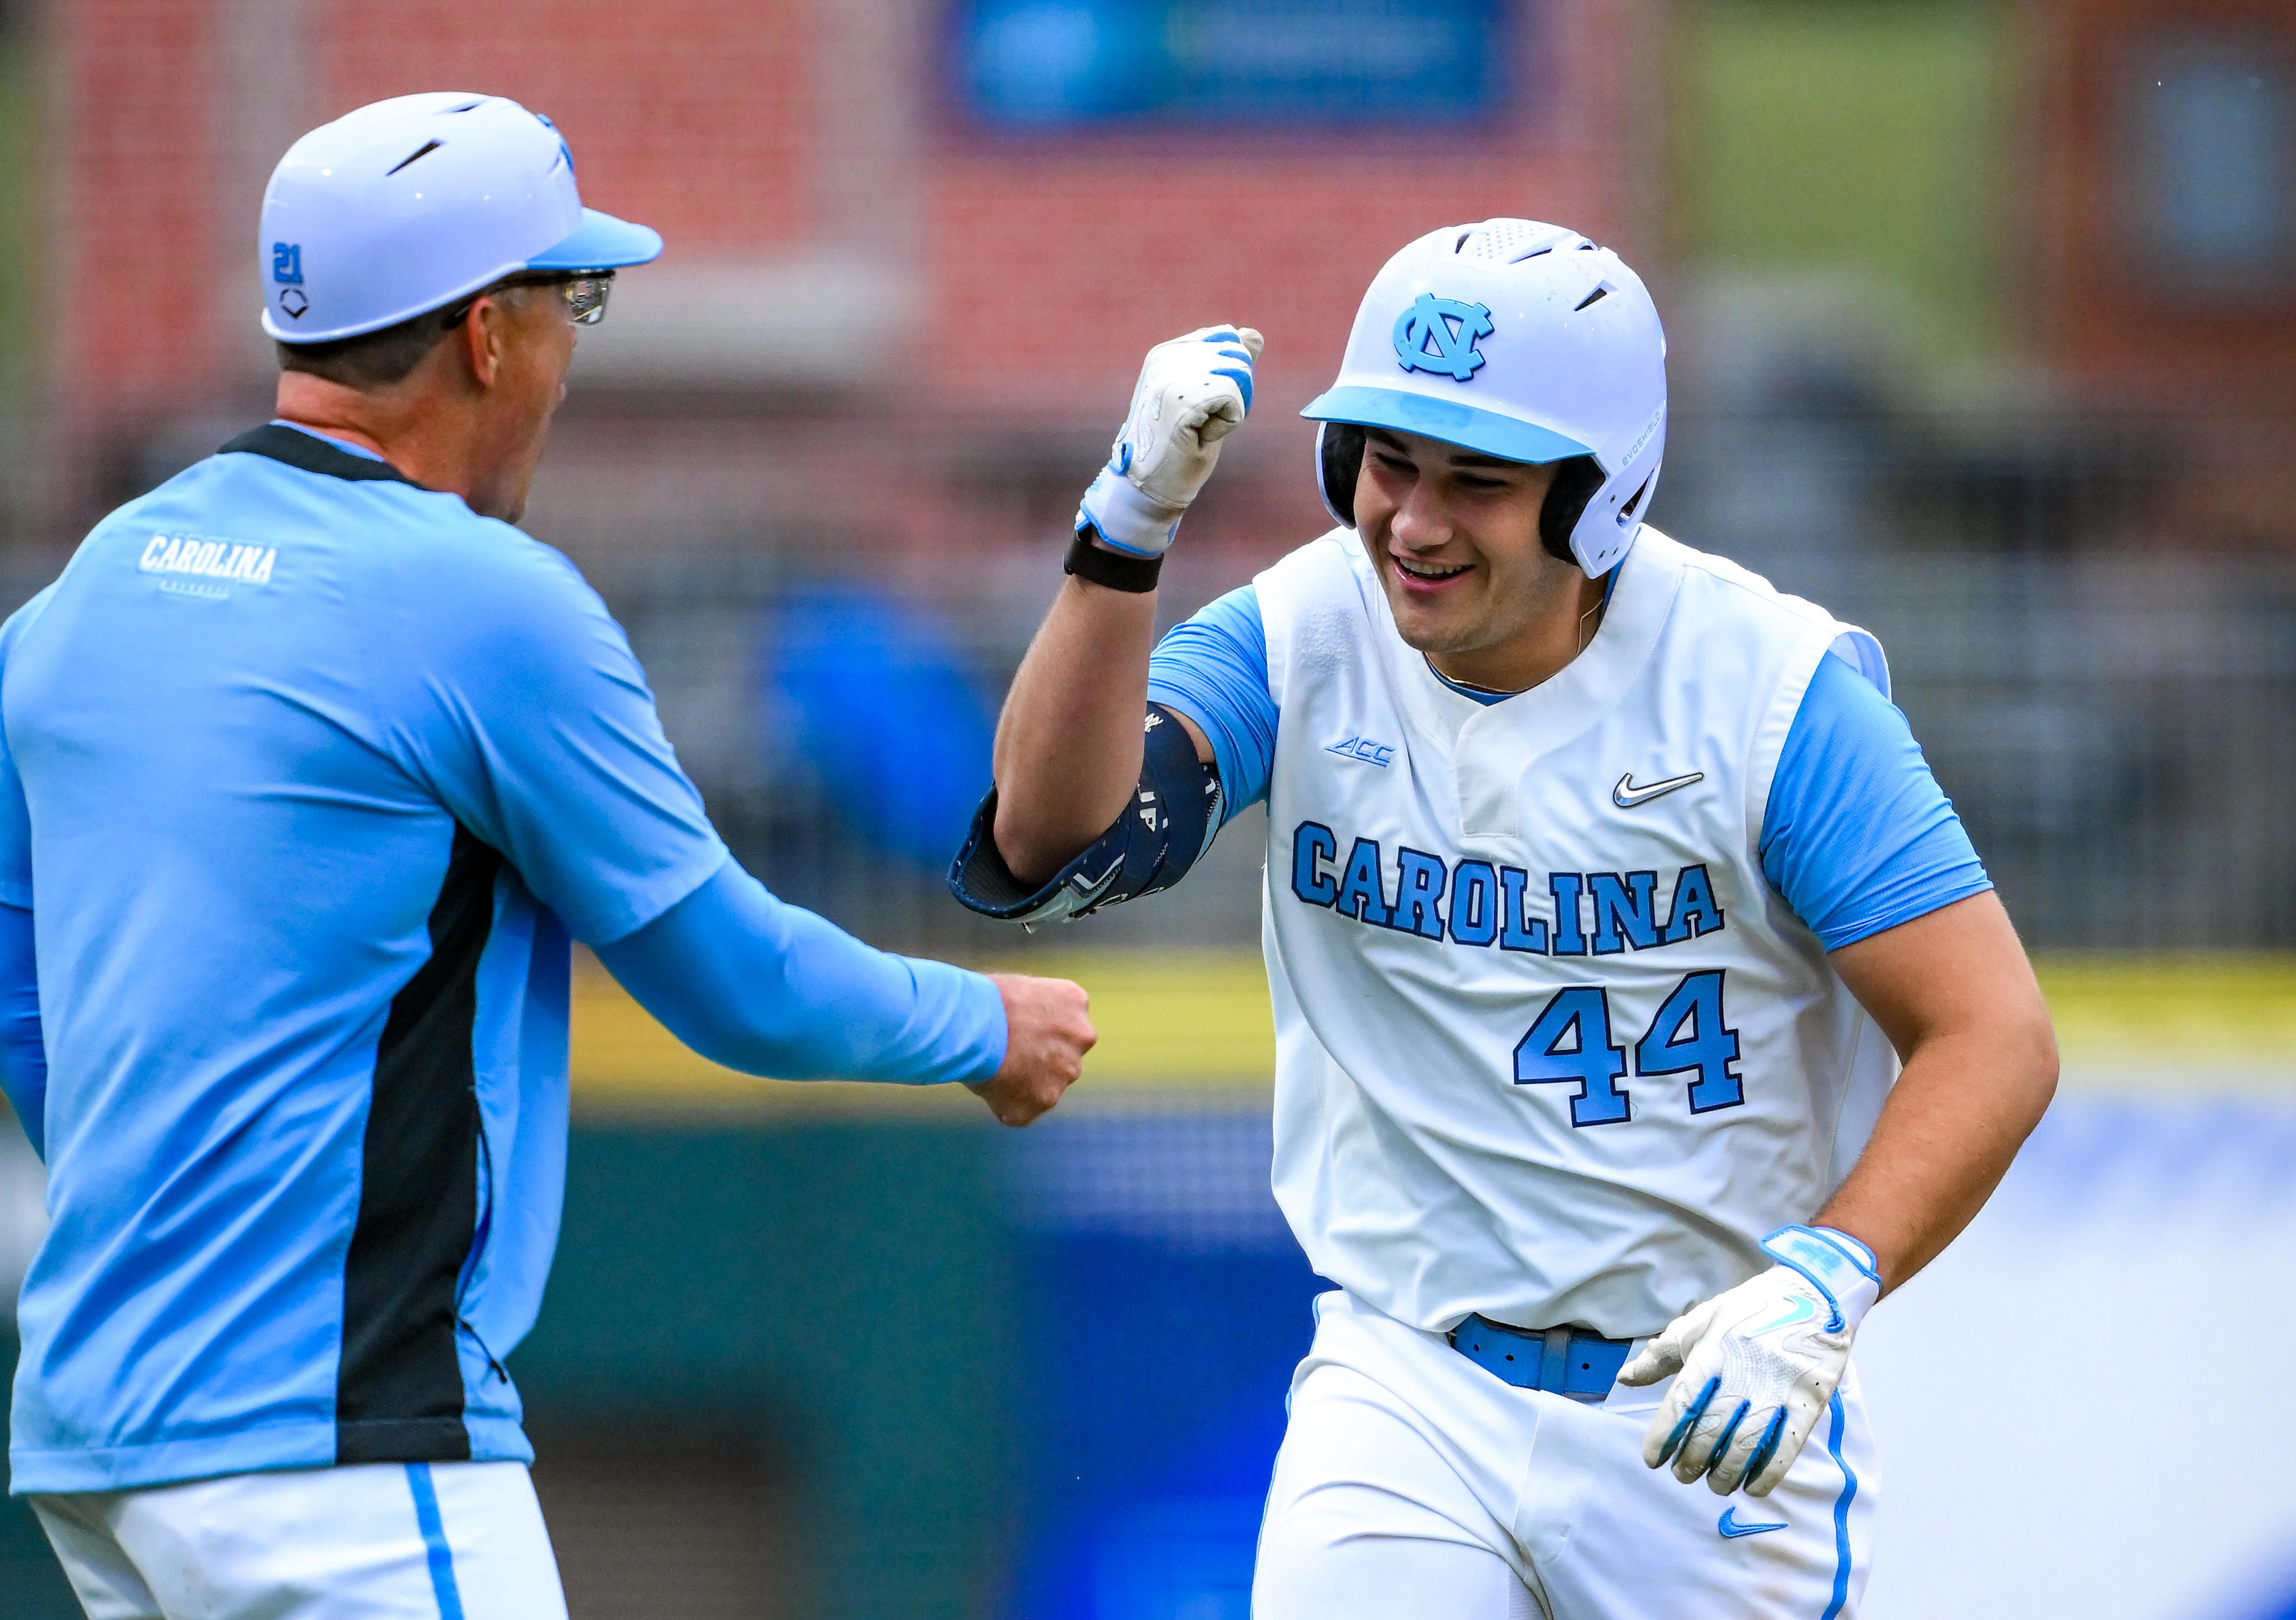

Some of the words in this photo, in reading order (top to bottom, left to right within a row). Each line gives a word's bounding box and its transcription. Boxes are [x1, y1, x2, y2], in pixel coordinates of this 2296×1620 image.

[274, 243, 303, 283] 21
[140, 535, 276, 583] CAROLINA
[1333, 737, 1396, 763] ACC
[1292, 820, 1725, 956] CAROLINA
[1513, 969, 1744, 1128] 44
